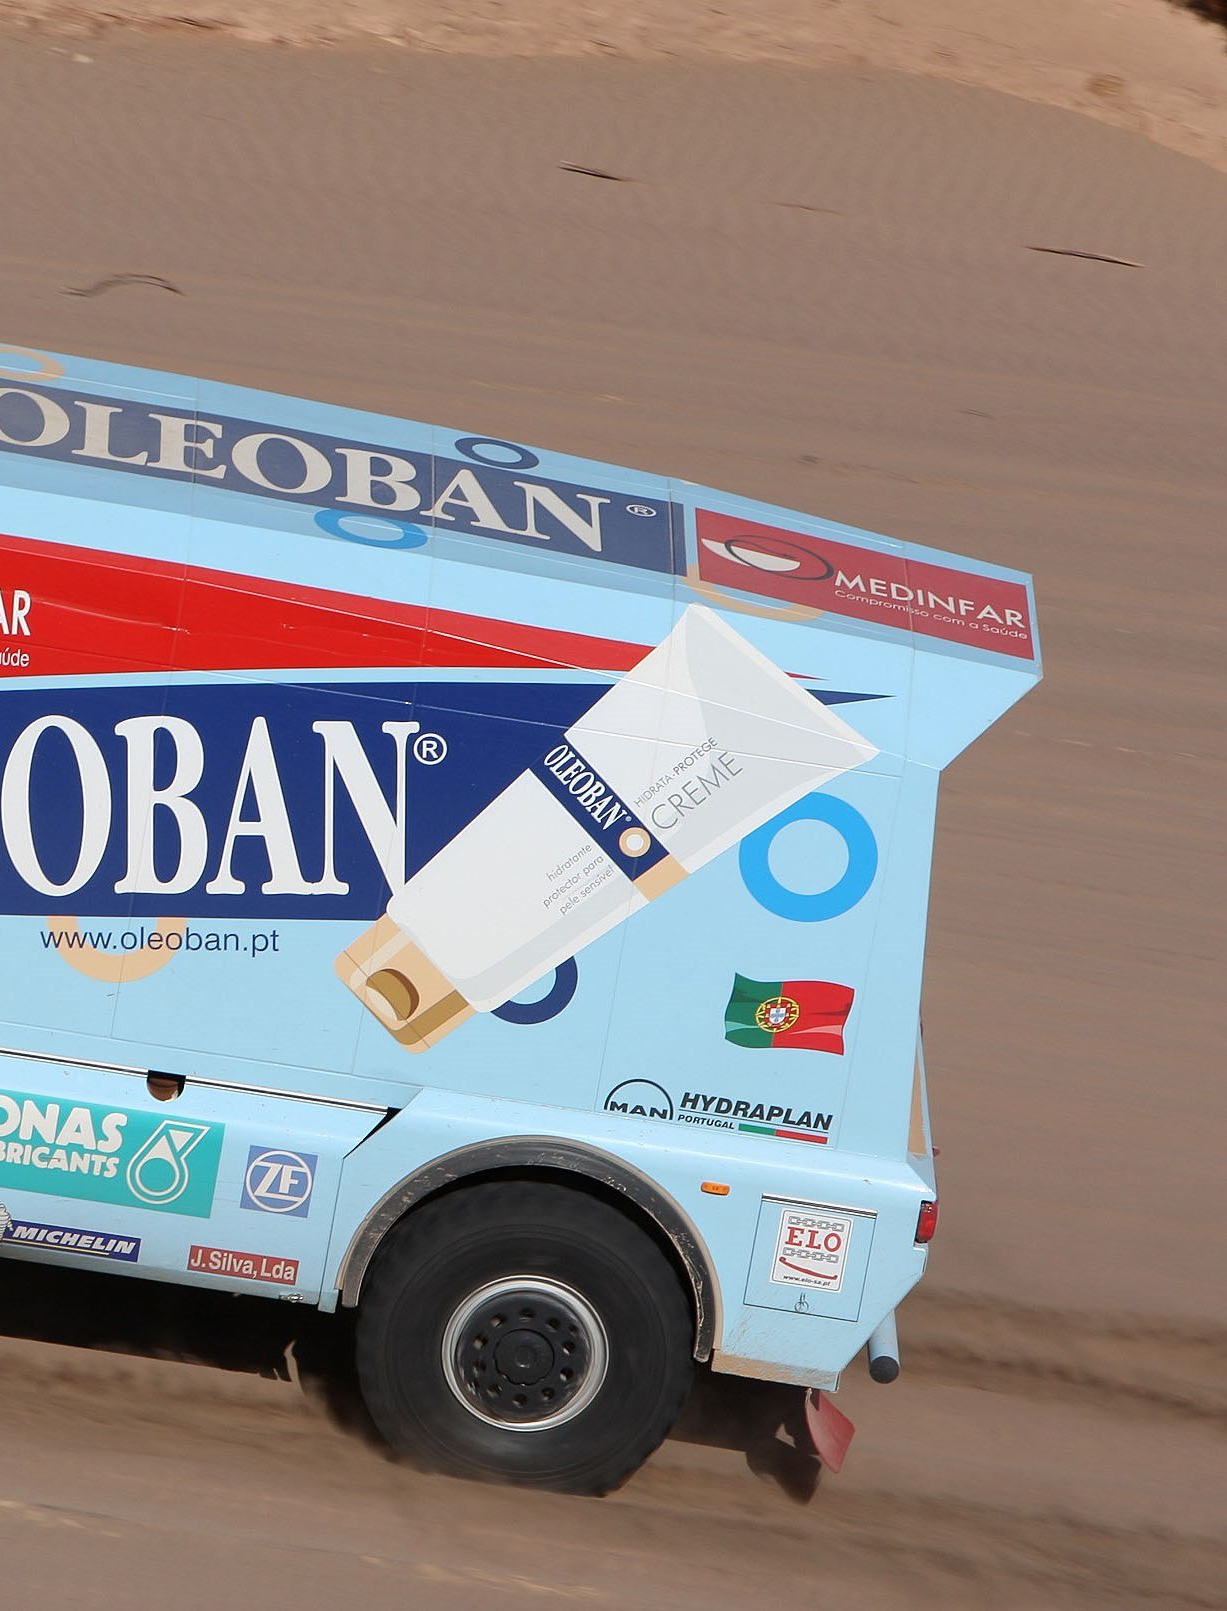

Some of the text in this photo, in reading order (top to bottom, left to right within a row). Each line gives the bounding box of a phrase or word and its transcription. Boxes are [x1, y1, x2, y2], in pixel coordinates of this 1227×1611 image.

[834, 570, 1026, 629] MEDINFAR
[834, 589, 930, 618] Compromisso
[933, 612, 966, 626] com
[969, 621, 979, 629] a
[652, 751, 743, 829] CREME
[543, 855, 604, 909] protector para
[546, 844, 592, 882] hidratante
[559, 895, 580, 916] pele
[40, 926, 280, 957] www.oleoban.pt
[609, 1092, 833, 1131] MAN HYDRAPLAN
[677, 1114, 735, 1130] PORTUGAL
[252, 1160, 309, 1202] ZF
[12, 1224, 136, 1256] MICHELIN
[190, 1249, 206, 1268] J.
[784, 1226, 842, 1253] ELO
